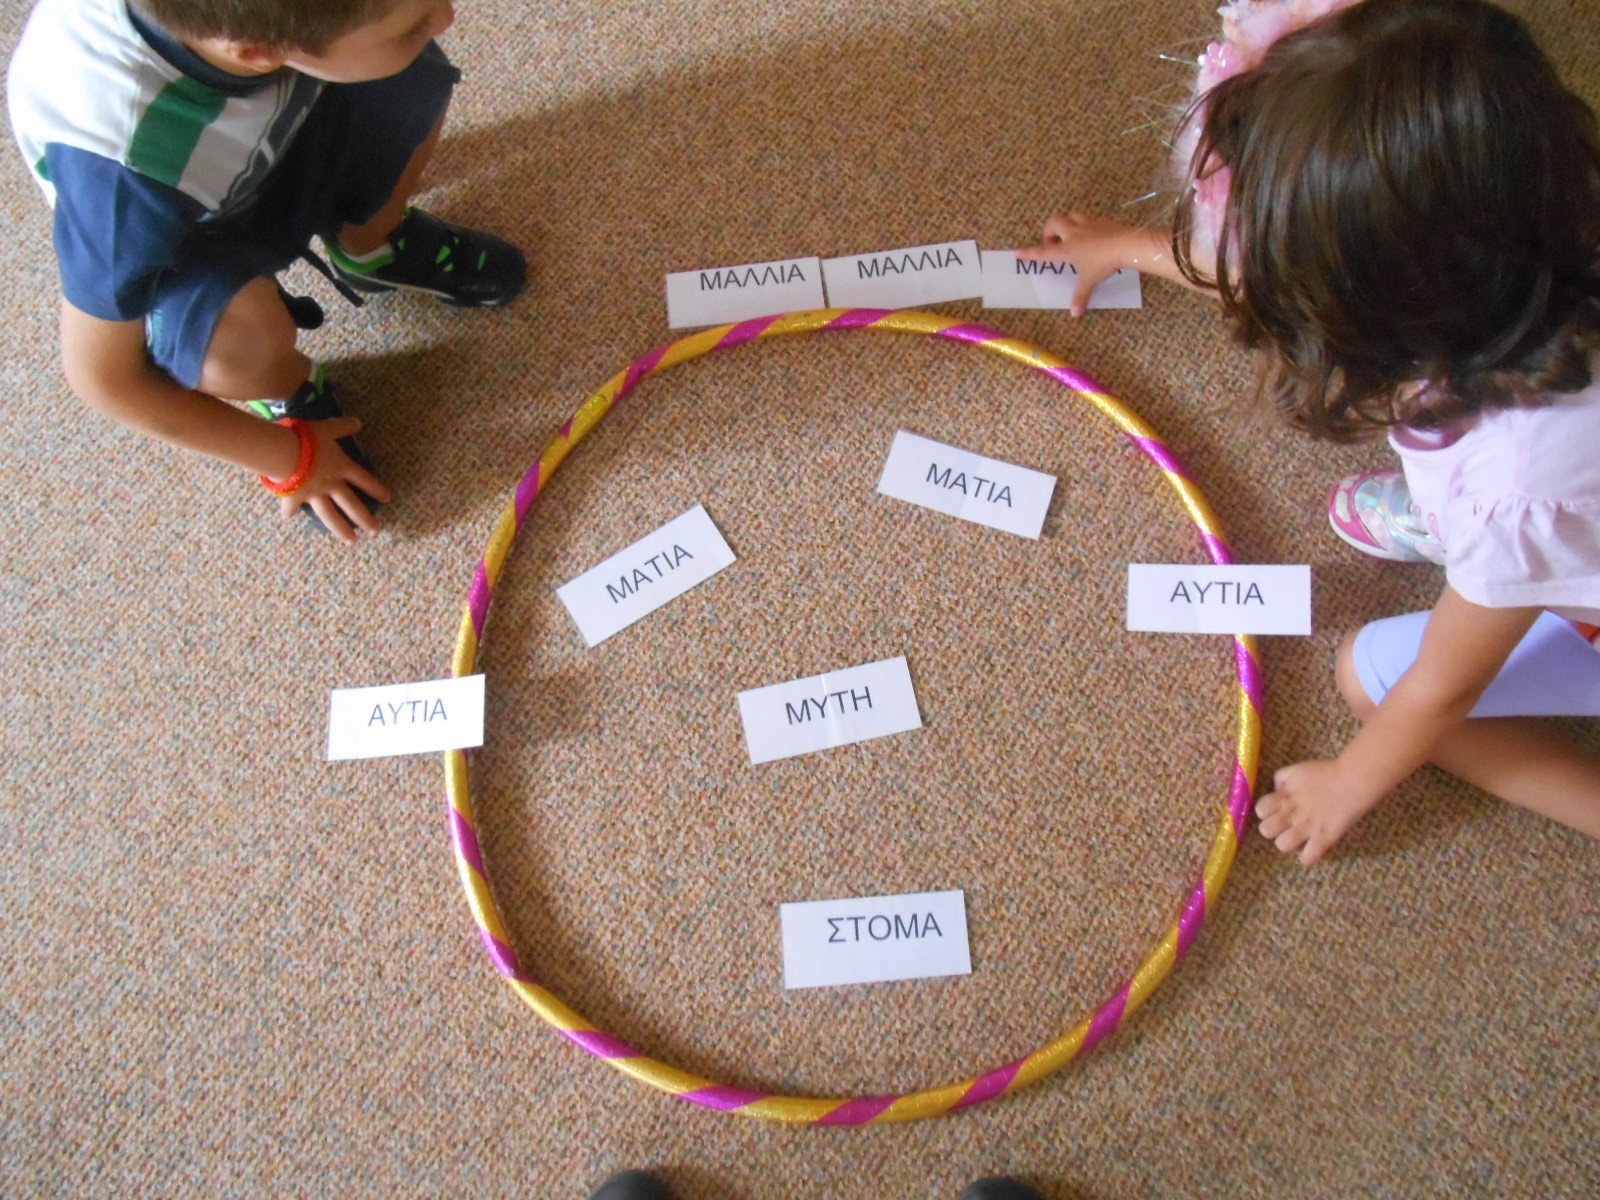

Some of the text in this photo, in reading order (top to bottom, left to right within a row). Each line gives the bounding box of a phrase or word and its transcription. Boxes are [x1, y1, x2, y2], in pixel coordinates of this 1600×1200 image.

[700, 263, 807, 291] ΜΑΛΛΙΑ
[857, 247, 964, 280] ΜΑΛΛΙΑ
[1016, 257, 1122, 275] ΜΑΛ
[925, 462, 1013, 508] ΜΑΤΙΑ
[605, 543, 694, 605] ΜΑΤΙΑ
[1170, 580, 1265, 606] ΑΥΤΙΑ
[367, 697, 448, 727] ΑΥΤΙΑ
[785, 685, 874, 725] ΜΥΤΗ
[827, 912, 943, 944] ΣΤΟΜΑ
